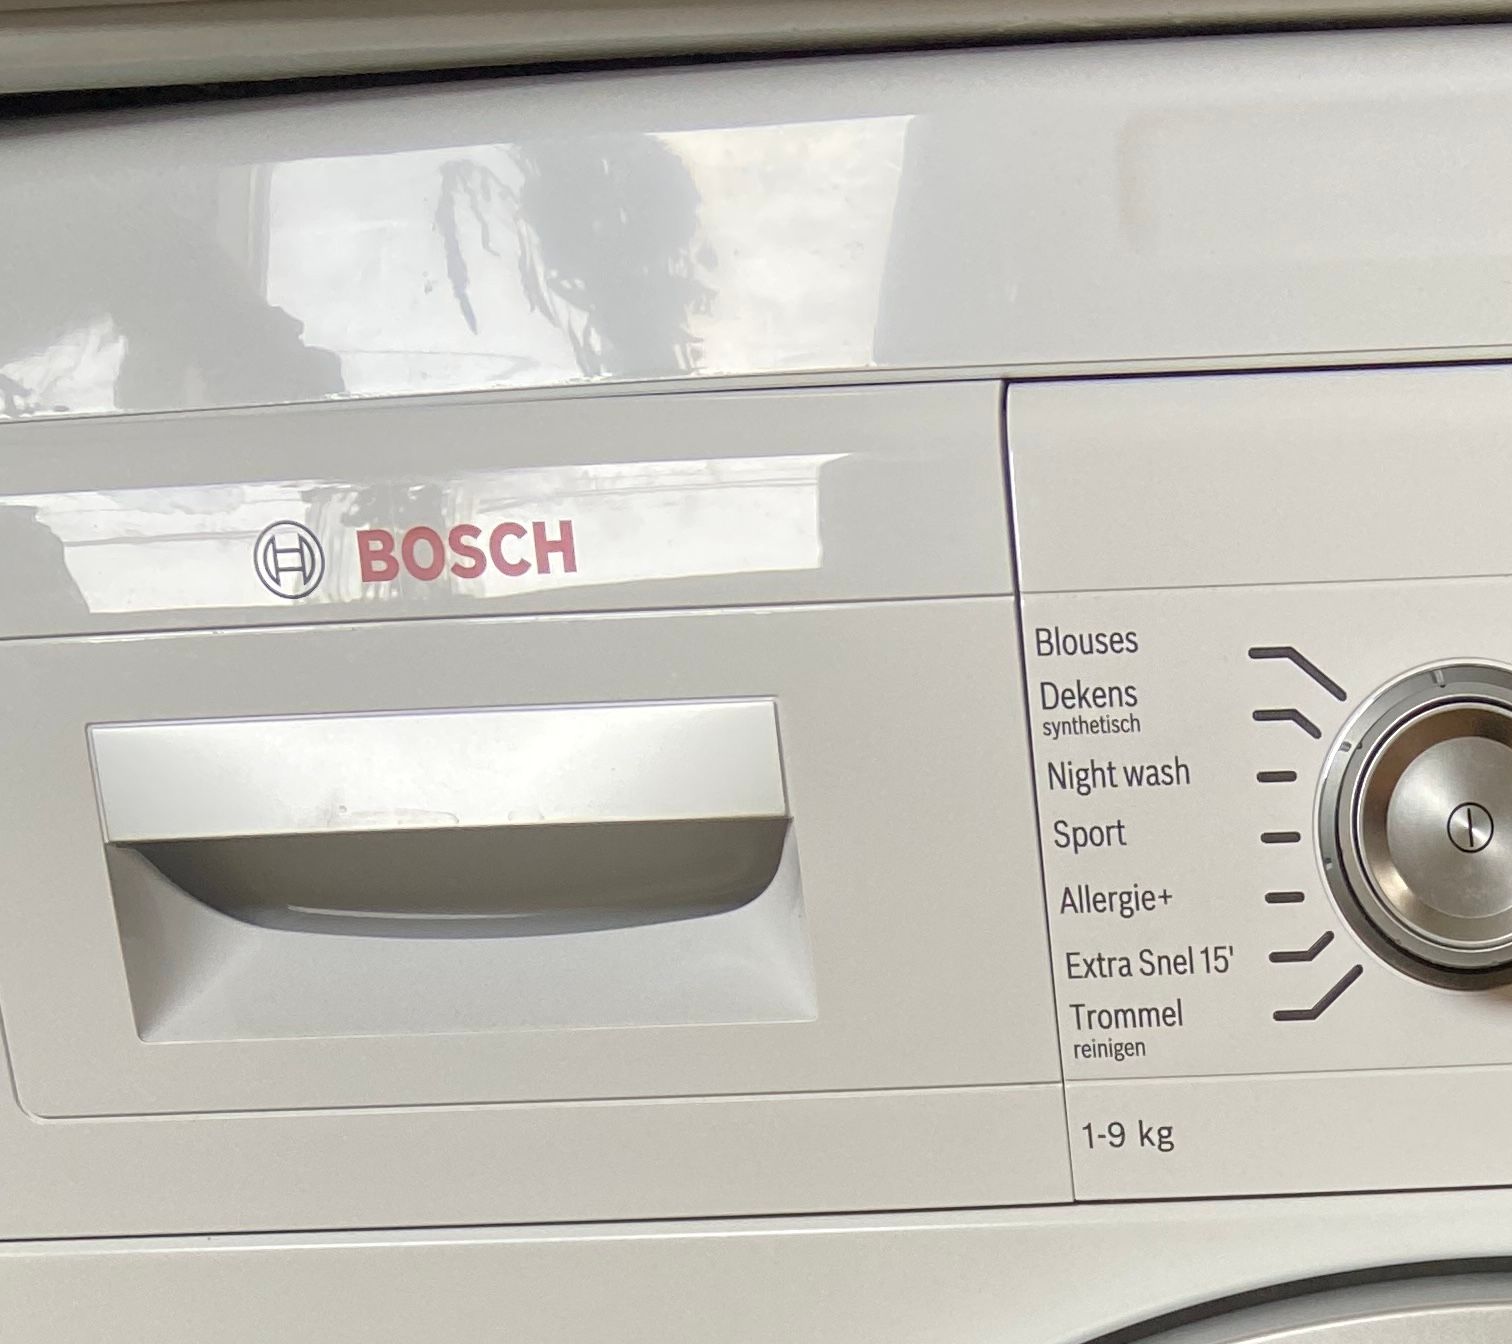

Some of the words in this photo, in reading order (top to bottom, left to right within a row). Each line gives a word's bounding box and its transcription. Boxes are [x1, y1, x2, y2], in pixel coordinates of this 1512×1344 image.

[356, 520, 577, 583] BOSCH
[1035, 626, 1139, 656] Blouses
[1040, 679, 1138, 710] Dekens
[1042, 713, 1141, 740] synthetisch
[1047, 759, 1118, 796] Night
[1123, 755, 1190, 787] wash
[1053, 819, 1127, 854] Sport
[1060, 883, 1173, 918] Allergie+
[1065, 952, 1133, 979] Extra
[1139, 946, 1194, 977] Snel
[1069, 998, 1183, 1030] Trommel
[1073, 1039, 1146, 1062] reinigen
[1082, 1121, 1126, 1149] 1-9
[1138, 1119, 1175, 1152] kg
